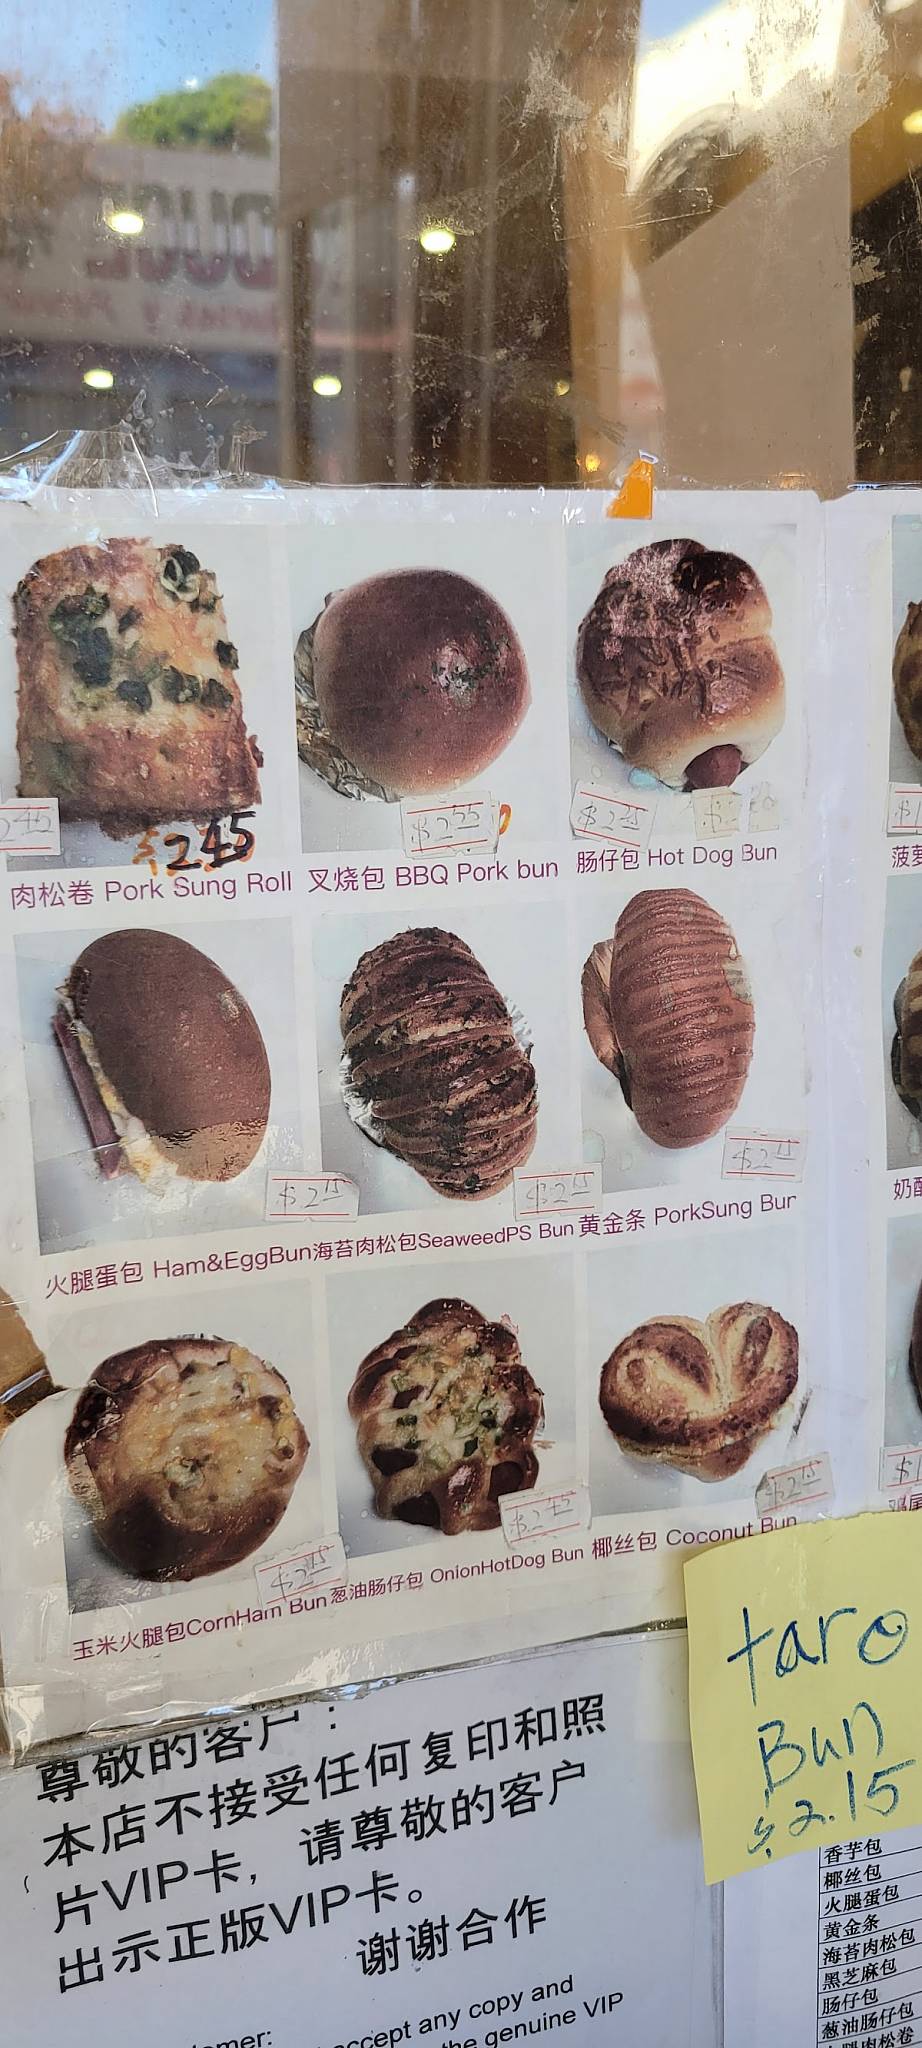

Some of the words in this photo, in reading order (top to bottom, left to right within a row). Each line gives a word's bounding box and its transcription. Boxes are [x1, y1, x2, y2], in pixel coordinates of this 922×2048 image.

[308, 865, 385, 893] 叉烧包
[396, 864, 449, 887] BBQ
[458, 861, 509, 882] Pork
[517, 859, 559, 879] bun
[577, 848, 640, 873] 肠仔包
[648, 848, 685, 866] Hot
[693, 846, 733, 868] Dog
[11, 880, 94, 910] 肉松卷
[105, 878, 164, 902] Pork
[174, 876, 237, 900] Sung
[248, 871, 292, 893] Roll
[539, 1222, 574, 1239] Bun
[578, 1208, 646, 1238] 黄金条
[655, 1200, 752, 1226] PorkSung
[45, 1260, 144, 1299] 火腿蛋包
[153, 1245, 312, 1279] Ham&EggBun
[592, 1531, 657, 1560] 椰丝包
[666, 1521, 754, 1546] Coconut
[761, 1516, 797, 1534] Bun
[430, 1552, 546, 1583] OnionHotDog
[551, 1547, 584, 1564] Bun
[290, 1597, 328, 1614] Bun
[726, 1606, 909, 1707] taro
[758, 1700, 885, 1808] Bun
[43, 1693, 608, 1868] 本店不接受任何复印和照
[824, 1838, 883, 1864] 香芋包
[824, 1864, 882, 1890] 椰丝包
[823, 1884, 900, 1916] 火腿蛋包
[356, 1894, 548, 1977] 谢谢合作
[823, 1913, 881, 1940] 黄金条
[822, 1928, 916, 1965] 海苔肉松包
[822, 1958, 897, 1990] 黑芝麻包
[419, 2008, 461, 2034] any
[469, 1991, 523, 2019] copy
[531, 1974, 574, 2001] and
[485, 2009, 577, 2048] genuine
[583, 1991, 624, 2018] VIP
[822, 1988, 879, 2016] 肠仔包
[822, 2002, 915, 2040] 葱油肠仔包
